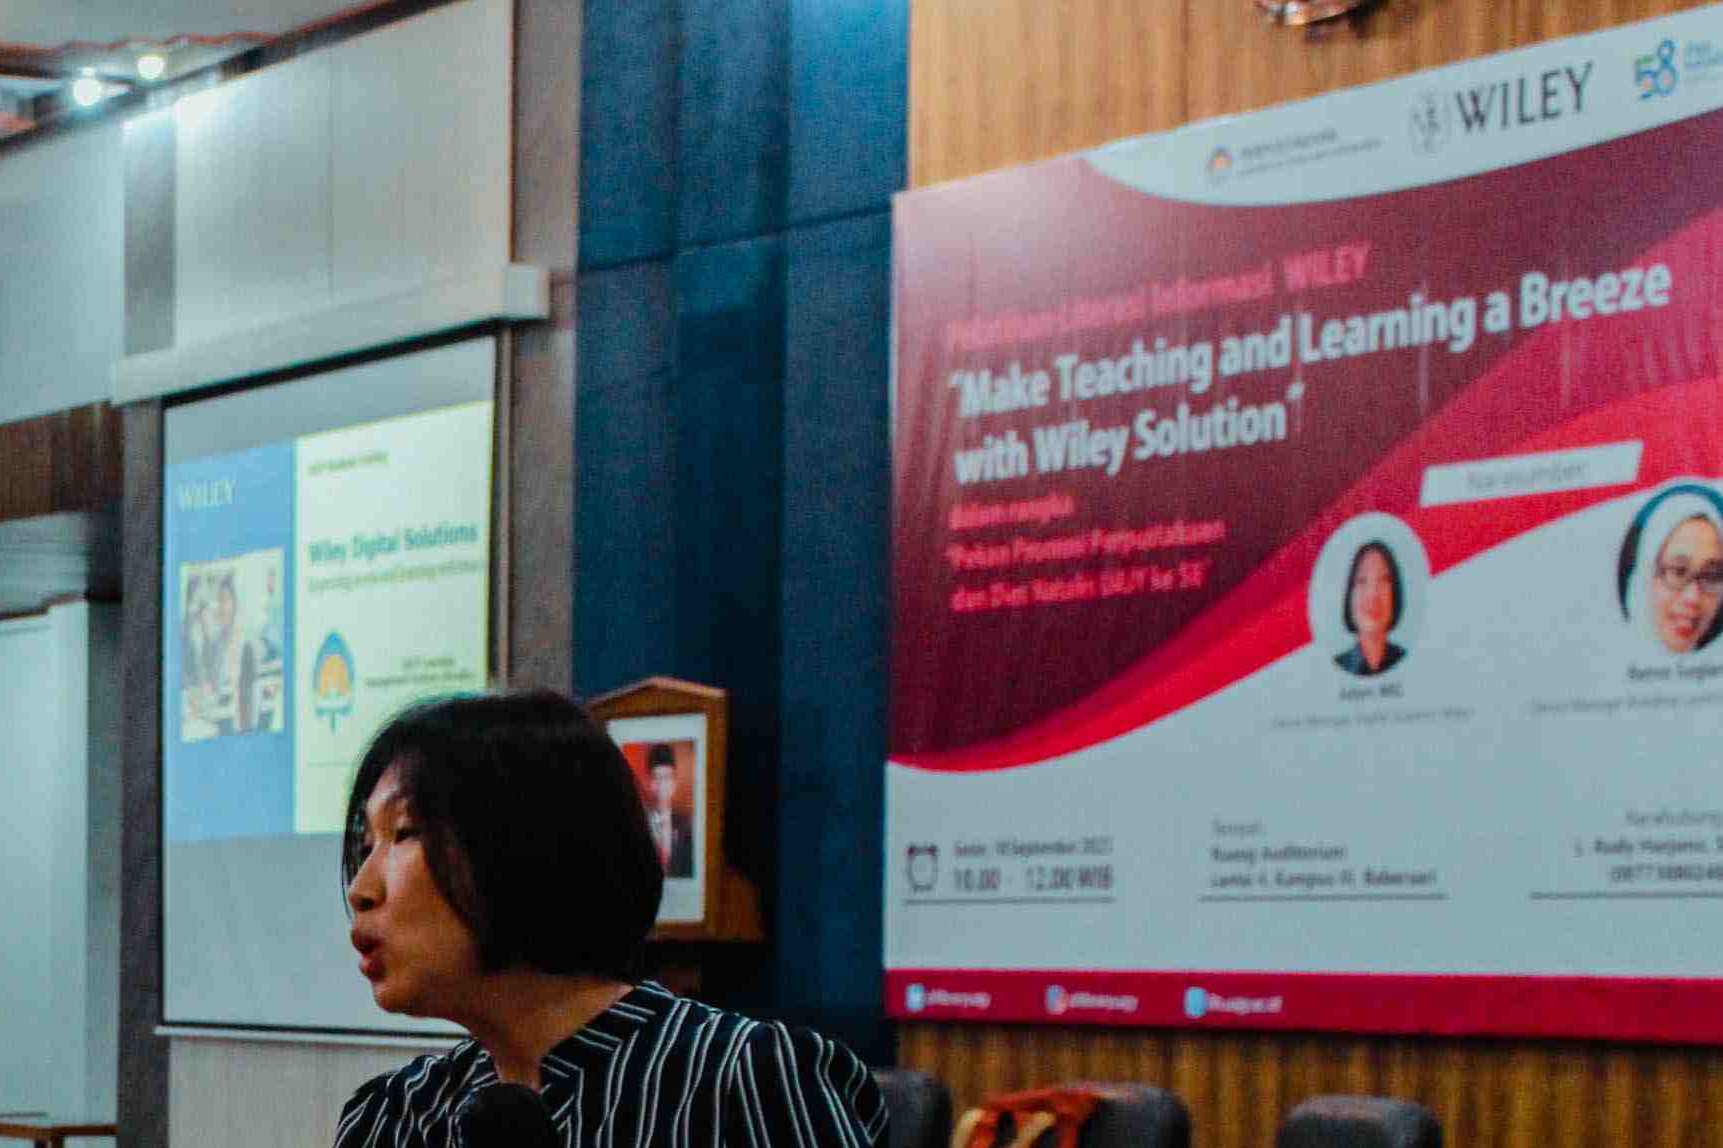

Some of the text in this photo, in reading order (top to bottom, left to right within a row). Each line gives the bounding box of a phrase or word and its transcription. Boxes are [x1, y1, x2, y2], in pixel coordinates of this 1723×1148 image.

[1454, 60, 1594, 136] WILEY
[1282, 242, 1372, 292] WILEY
[1055, 337, 1214, 396] Teaching
[1218, 313, 1292, 377] and
[1298, 291, 1477, 364] Learning
[1483, 290, 1511, 334] a
[1520, 263, 1673, 330] Breeze
[953, 429, 1029, 487] with
[1032, 418, 1129, 477] Wiley
[177, 480, 235, 511] WILEY
[308, 523, 479, 566] Wiley Digital Solutions
